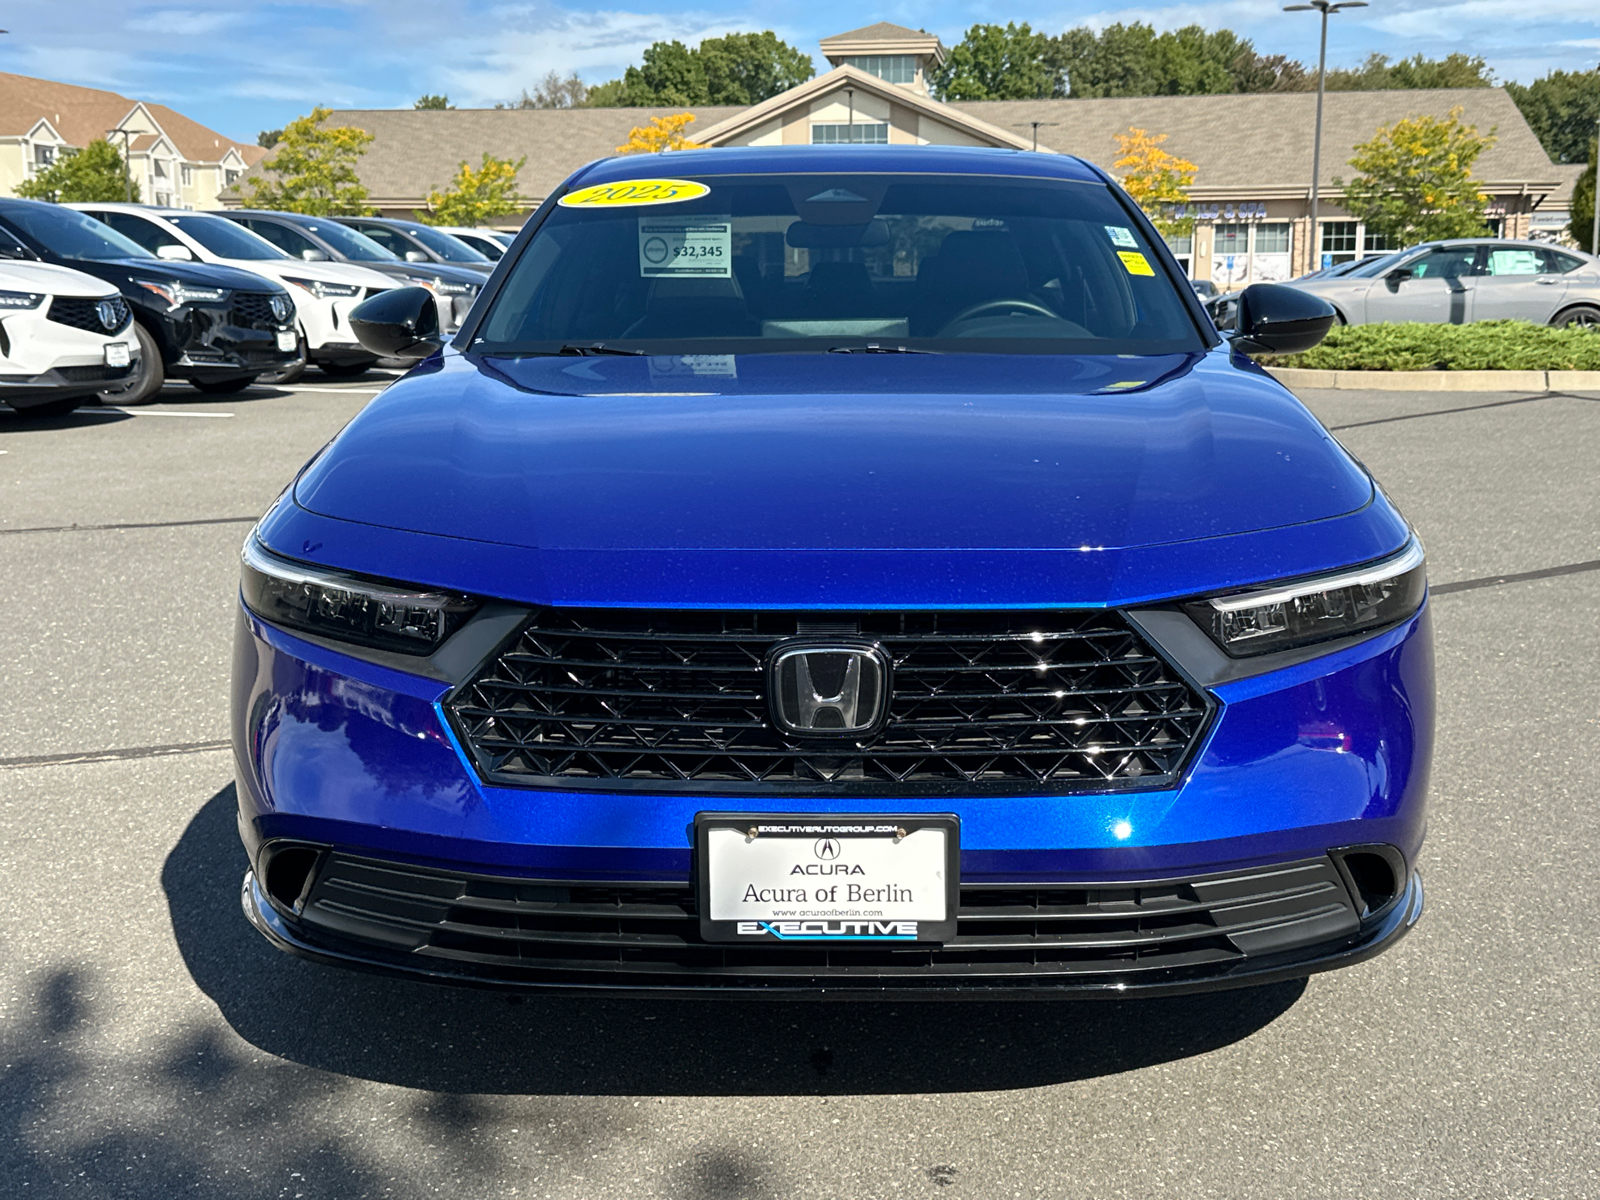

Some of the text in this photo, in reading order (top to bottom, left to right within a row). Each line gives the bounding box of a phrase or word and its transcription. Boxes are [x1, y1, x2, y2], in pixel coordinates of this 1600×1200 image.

[579, 184, 688, 204] 2025
[1223, 203, 1236, 219] &
[1238, 202, 1267, 218] SPA
[673, 246, 723, 259] $32,345
[757, 825, 898, 833] EXECUTIVEAUTOGROUP.COM
[790, 864, 866, 876] ACURA
[742, 883, 914, 903] Acura of Berlin
[772, 908, 883, 917] www.acuraofberlin.com
[737, 921, 918, 936] EXECUTIVE
